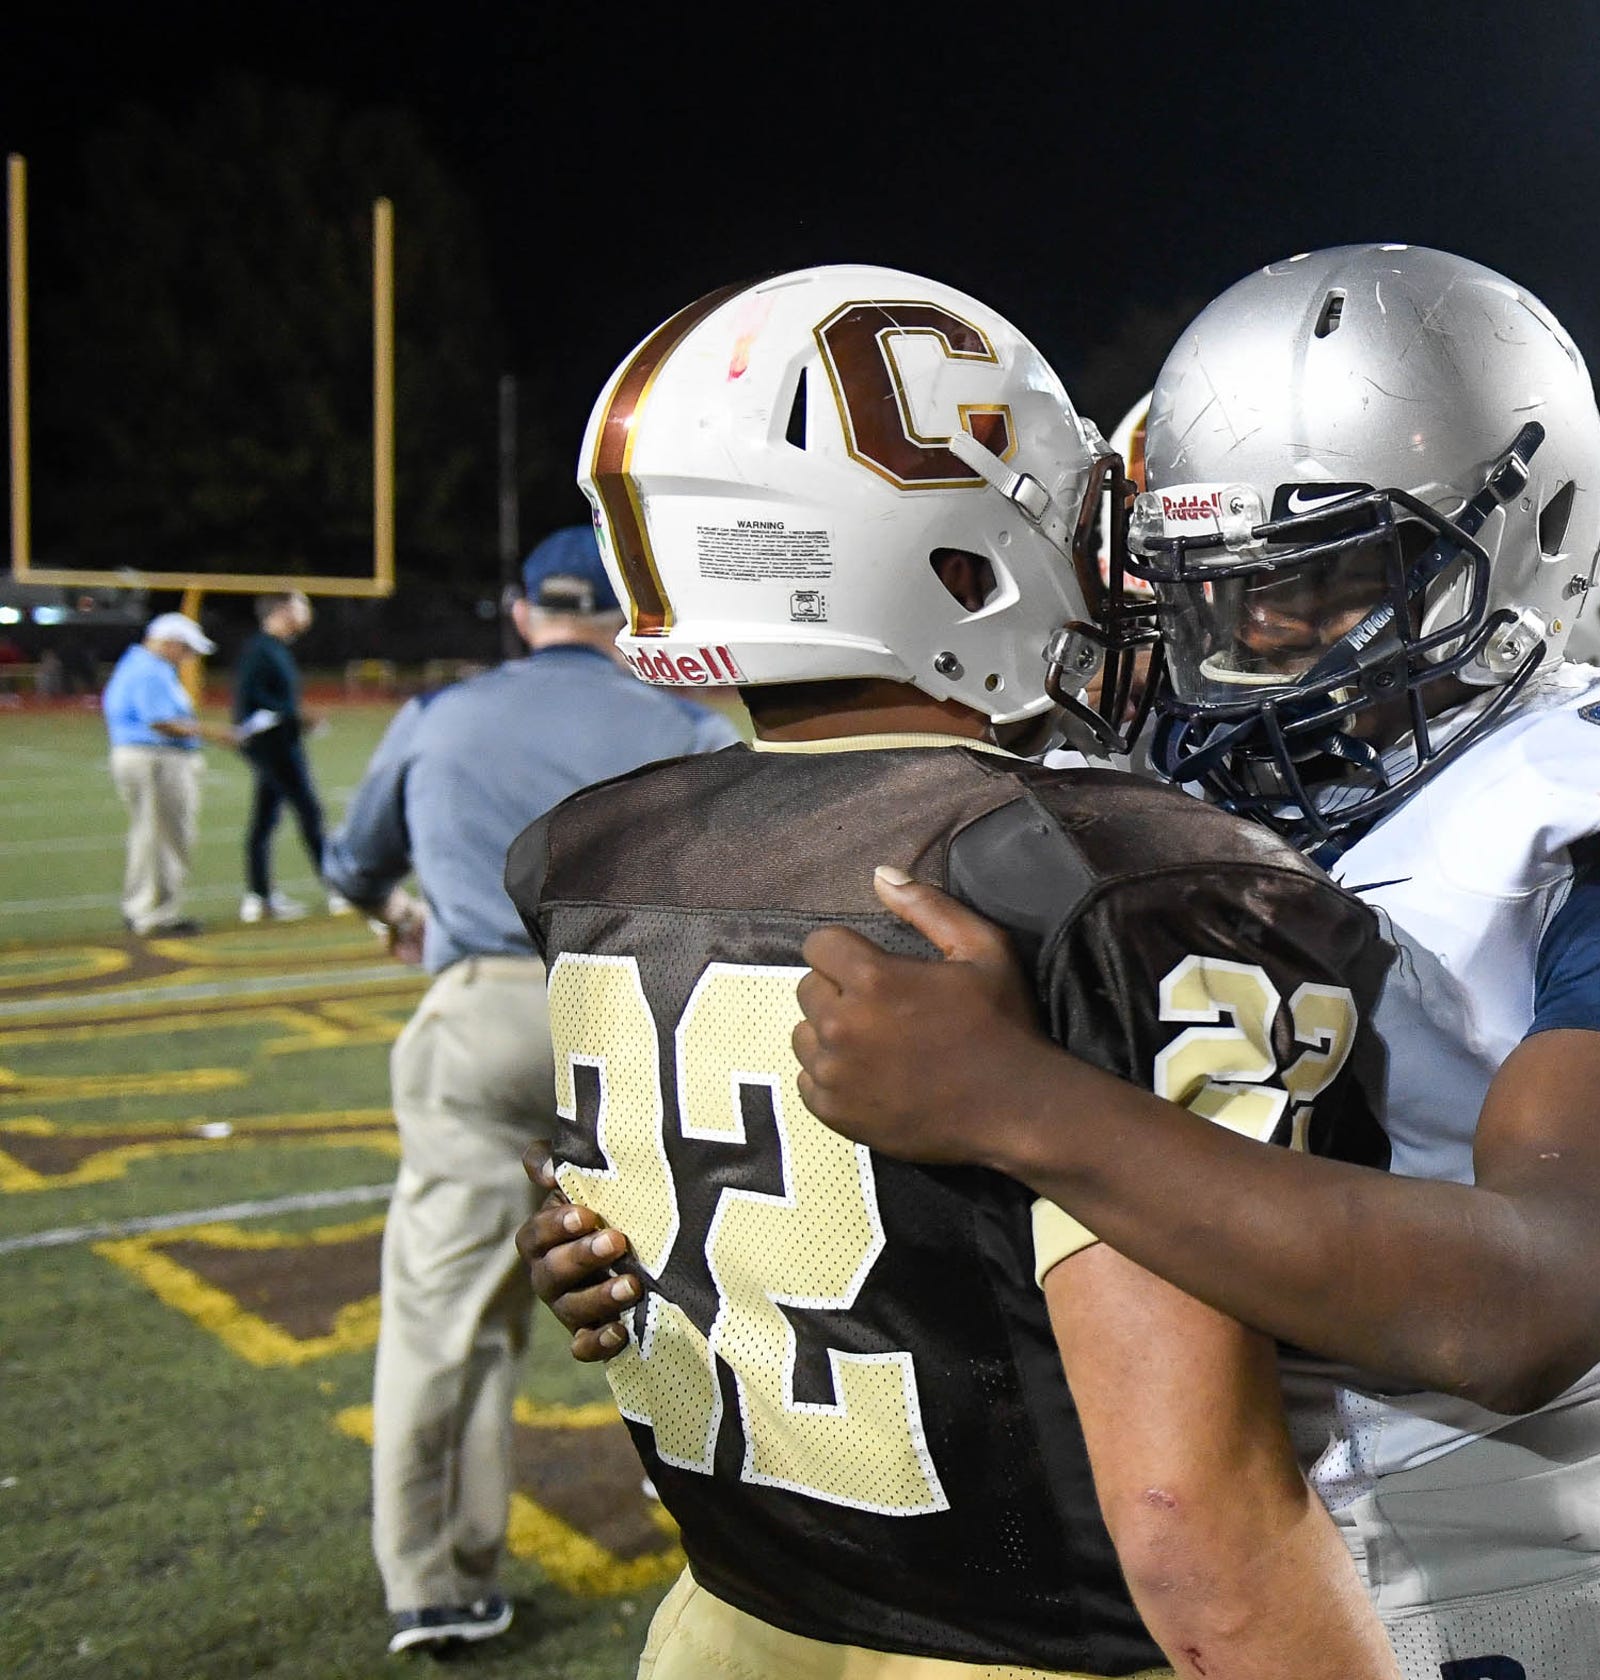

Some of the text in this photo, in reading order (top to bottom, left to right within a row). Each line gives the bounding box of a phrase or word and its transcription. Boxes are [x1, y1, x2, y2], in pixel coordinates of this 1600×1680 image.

[813, 300, 1017, 491] C
[736, 520, 785, 530] WARNING
[1154, 953, 1359, 1153] 22
[548, 952, 950, 1516] 22
